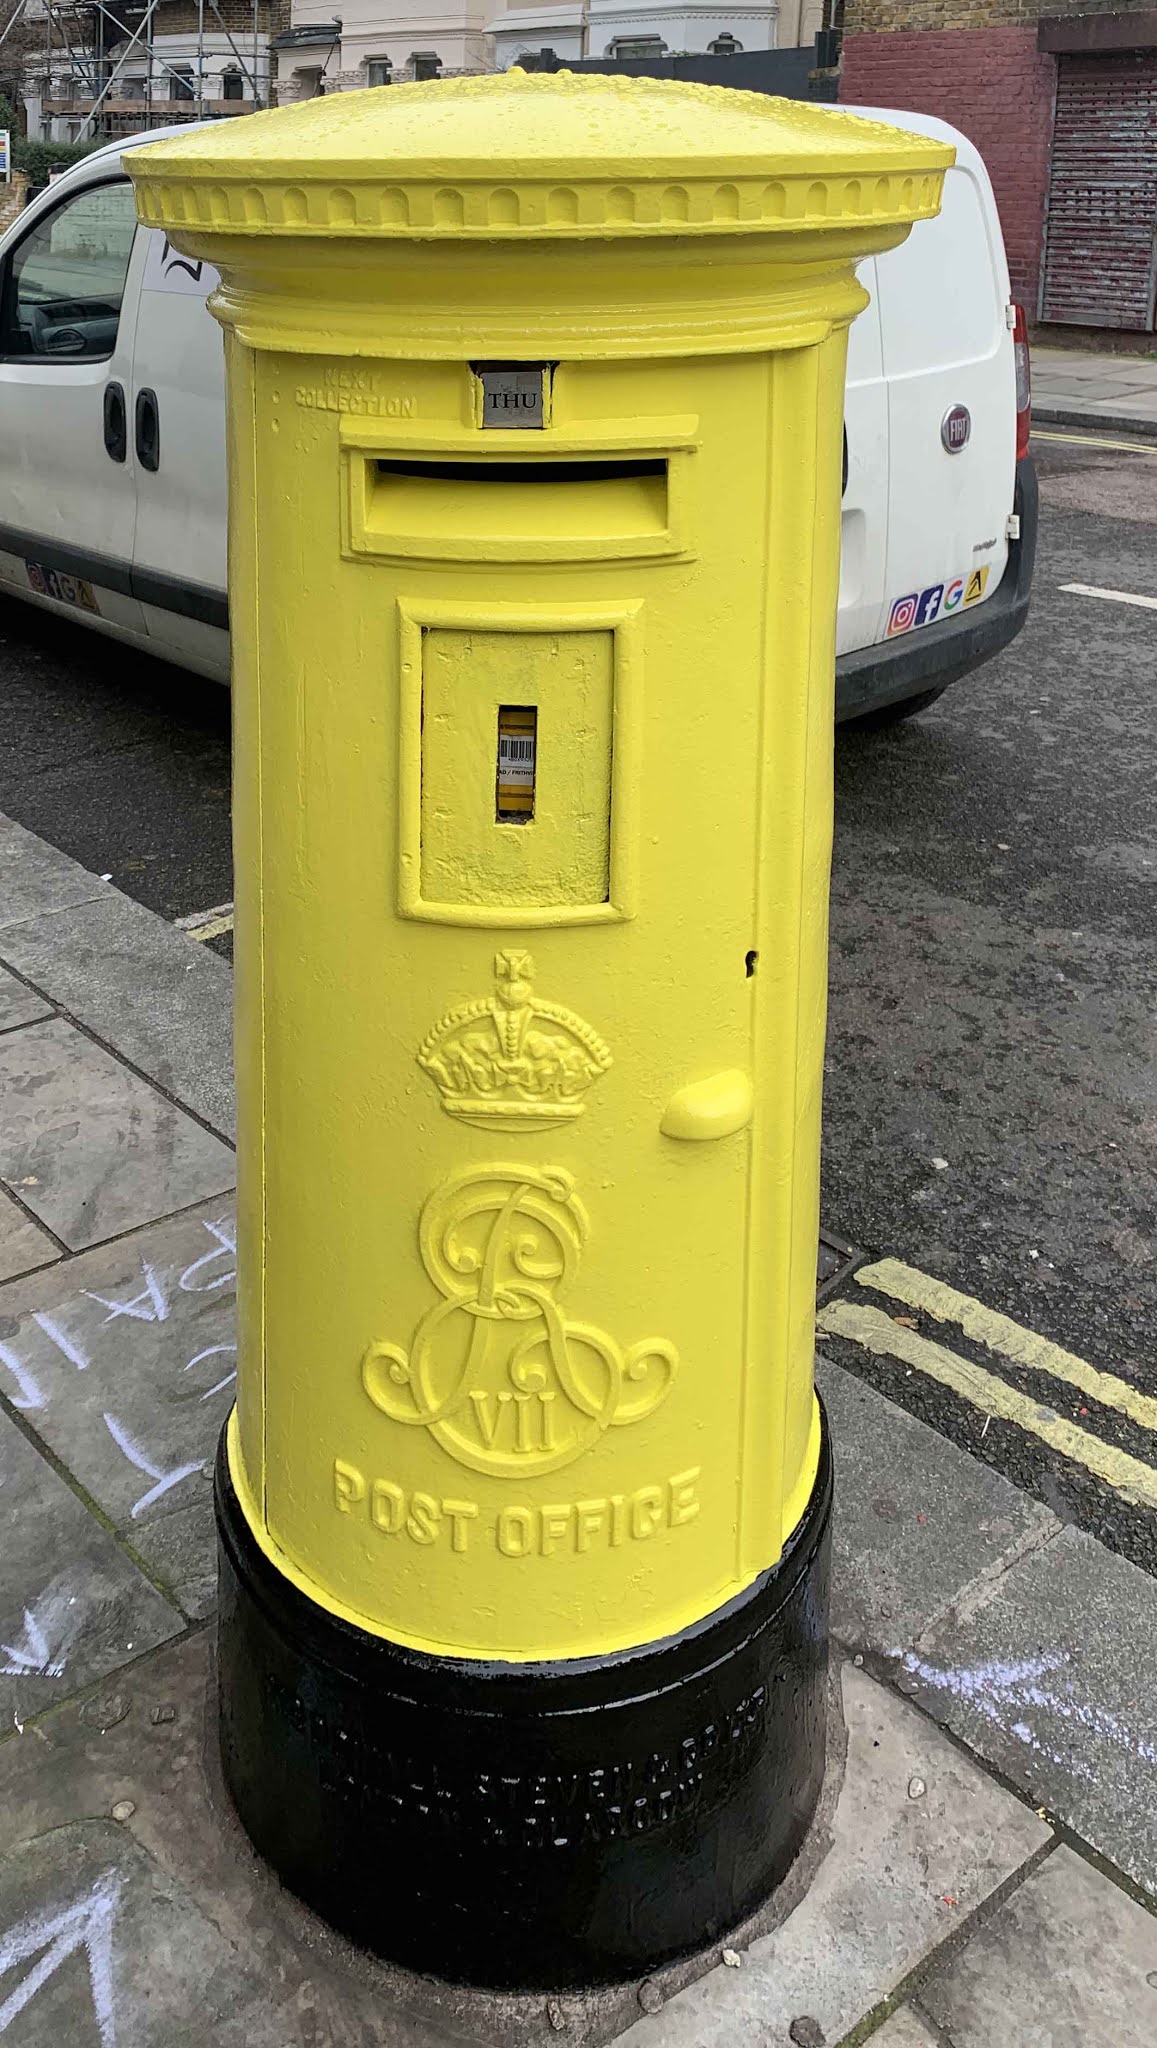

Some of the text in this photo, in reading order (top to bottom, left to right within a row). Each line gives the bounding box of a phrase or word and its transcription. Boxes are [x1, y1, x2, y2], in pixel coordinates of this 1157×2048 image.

[323, 367, 381, 391] NEXT
[295, 386, 418, 418] COLLECTION
[488, 393, 537, 409] THU
[950, 418, 967, 441] FIAT
[469, 1389, 556, 1453] VII
[334, 1457, 480, 1553] POST
[497, 1465, 701, 1558] OFFICE
